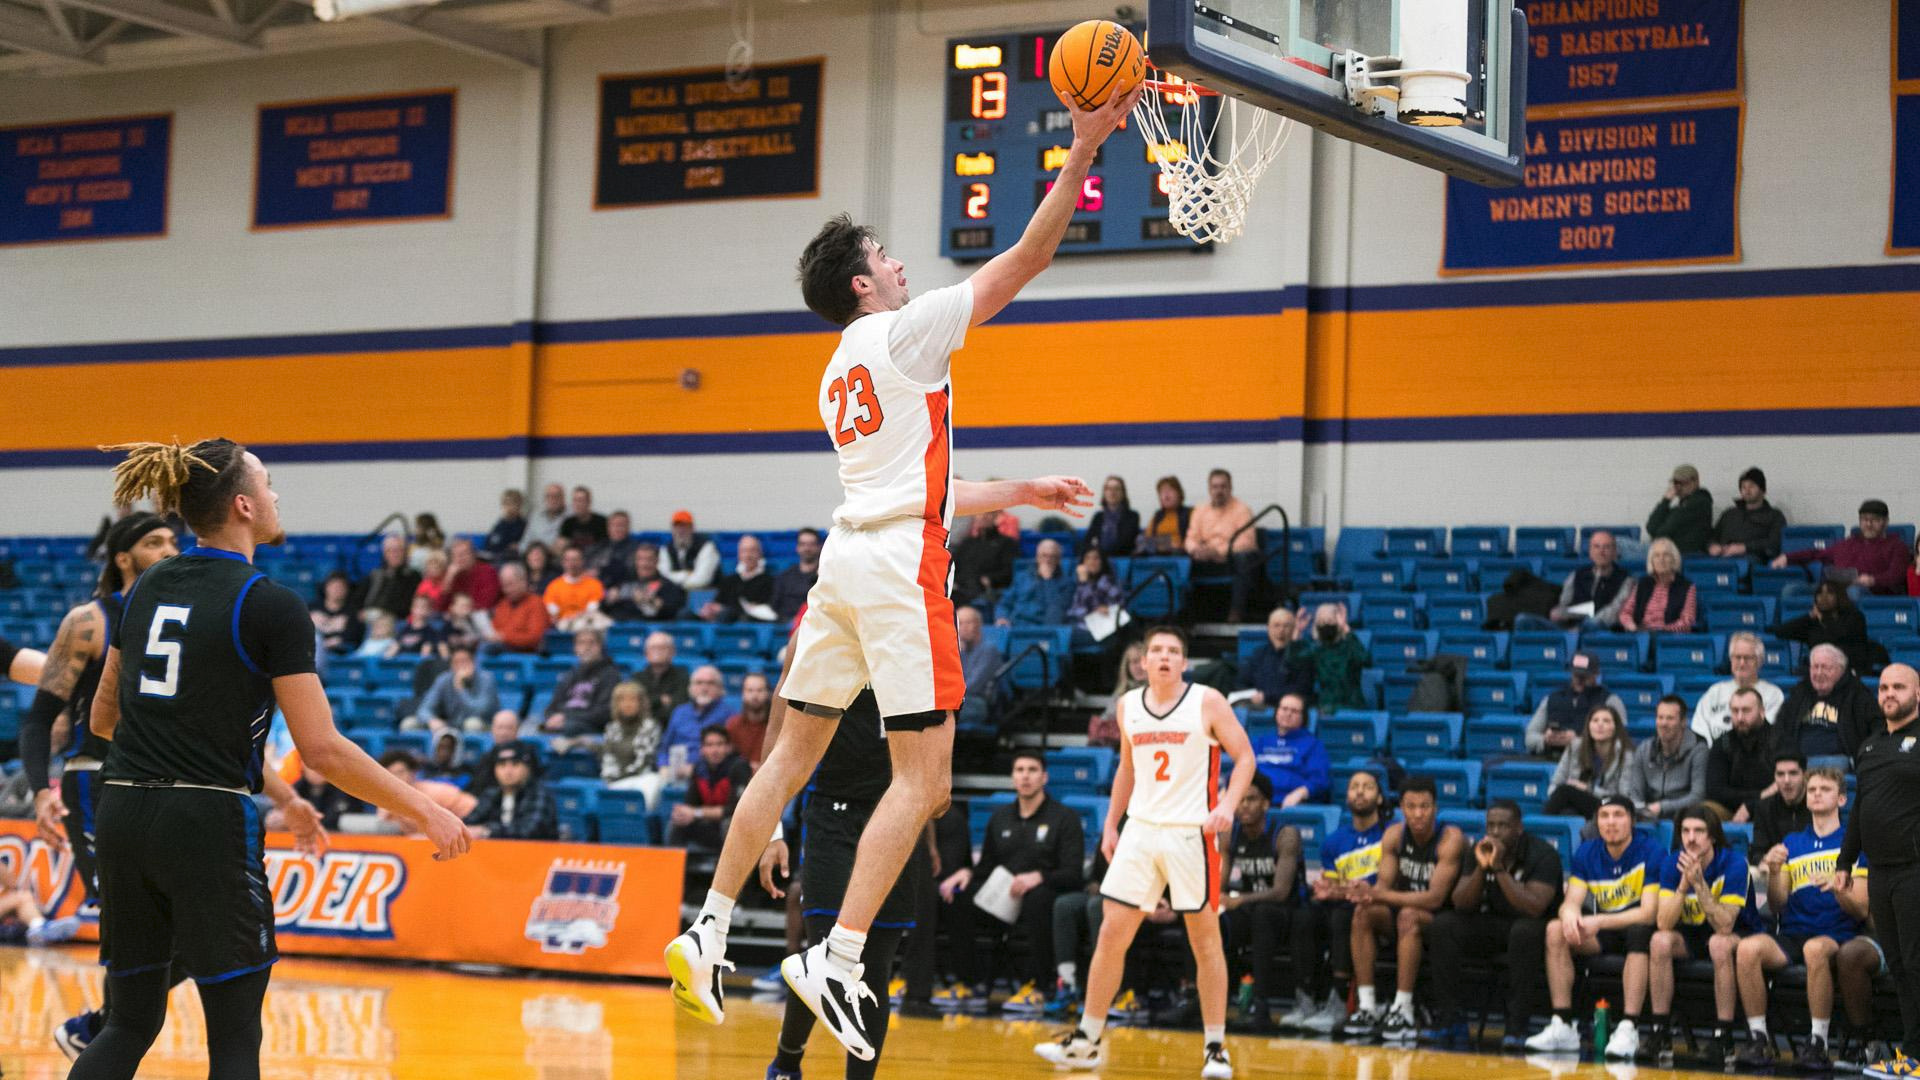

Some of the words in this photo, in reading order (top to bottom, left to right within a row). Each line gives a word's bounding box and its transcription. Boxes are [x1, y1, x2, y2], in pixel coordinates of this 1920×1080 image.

[1527, 0, 1659, 26] CHAMPIONS
[1561, 22, 1710, 56] BASKETBALL
[1568, 63, 1619, 88] 1957
[971, 72, 1007, 119] 13
[1559, 124, 1657, 152] DIVISION
[1670, 121, 1696, 145] III
[1524, 156, 1656, 188] CHAMPIONS
[967, 183, 990, 219] 2
[1490, 194, 1592, 222] WOMEN'S
[1605, 188, 1690, 215] SOCCER
[1559, 225, 1615, 251] 2007
[828, 364, 884, 447] 23
[139, 603, 193, 699] 5
[1153, 751, 1170, 782] 2
[264, 850, 407, 938] DER
